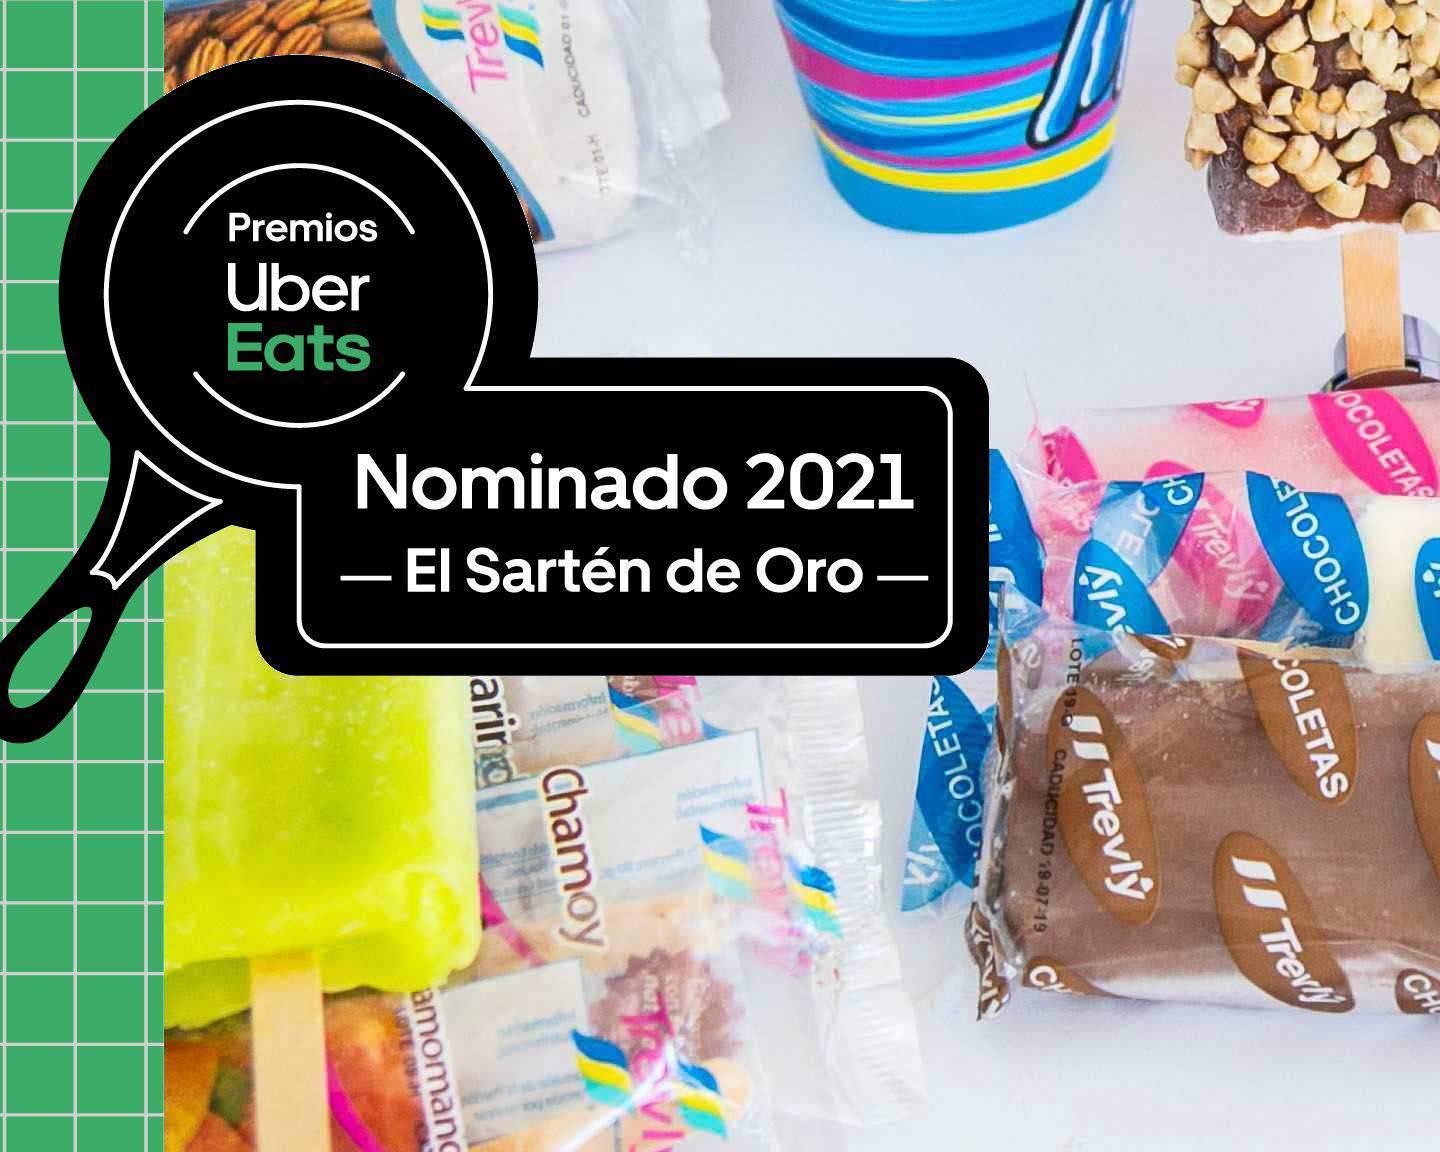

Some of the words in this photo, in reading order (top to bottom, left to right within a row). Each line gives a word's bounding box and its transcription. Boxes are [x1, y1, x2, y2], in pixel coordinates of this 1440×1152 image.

[1066, 637, 1085, 684] LOTE
[1040, 749, 1067, 856] CADUCIDAD
[1081, 775, 1155, 901] Trevly
[541, 766, 606, 949] Chamoy
[1259, 916, 1346, 1006] Trevly
